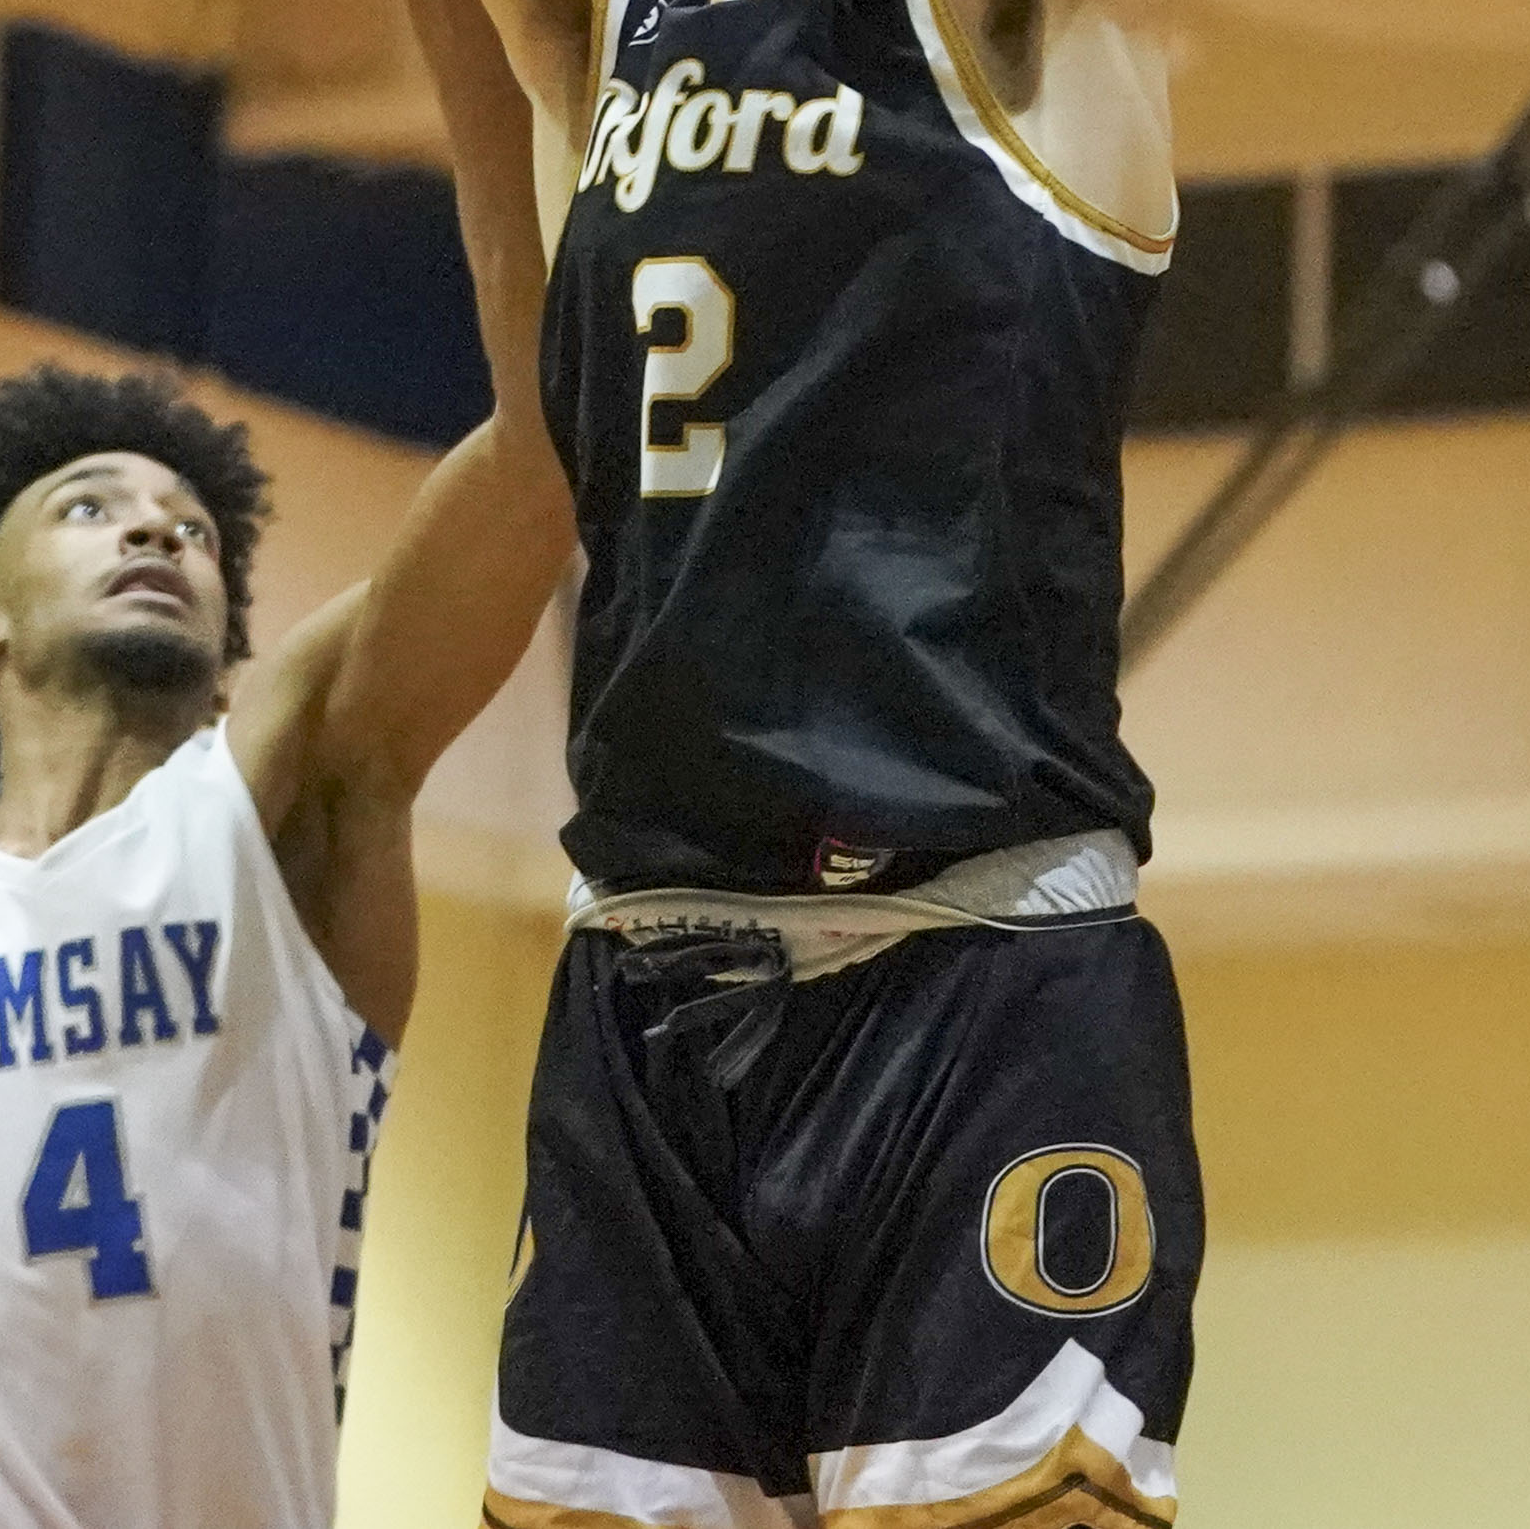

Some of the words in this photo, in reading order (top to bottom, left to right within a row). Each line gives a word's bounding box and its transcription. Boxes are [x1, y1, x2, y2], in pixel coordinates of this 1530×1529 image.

[632, 255, 736, 498] 2
[20, 1092, 160, 1308] 4
[980, 1142, 1157, 1319] O
